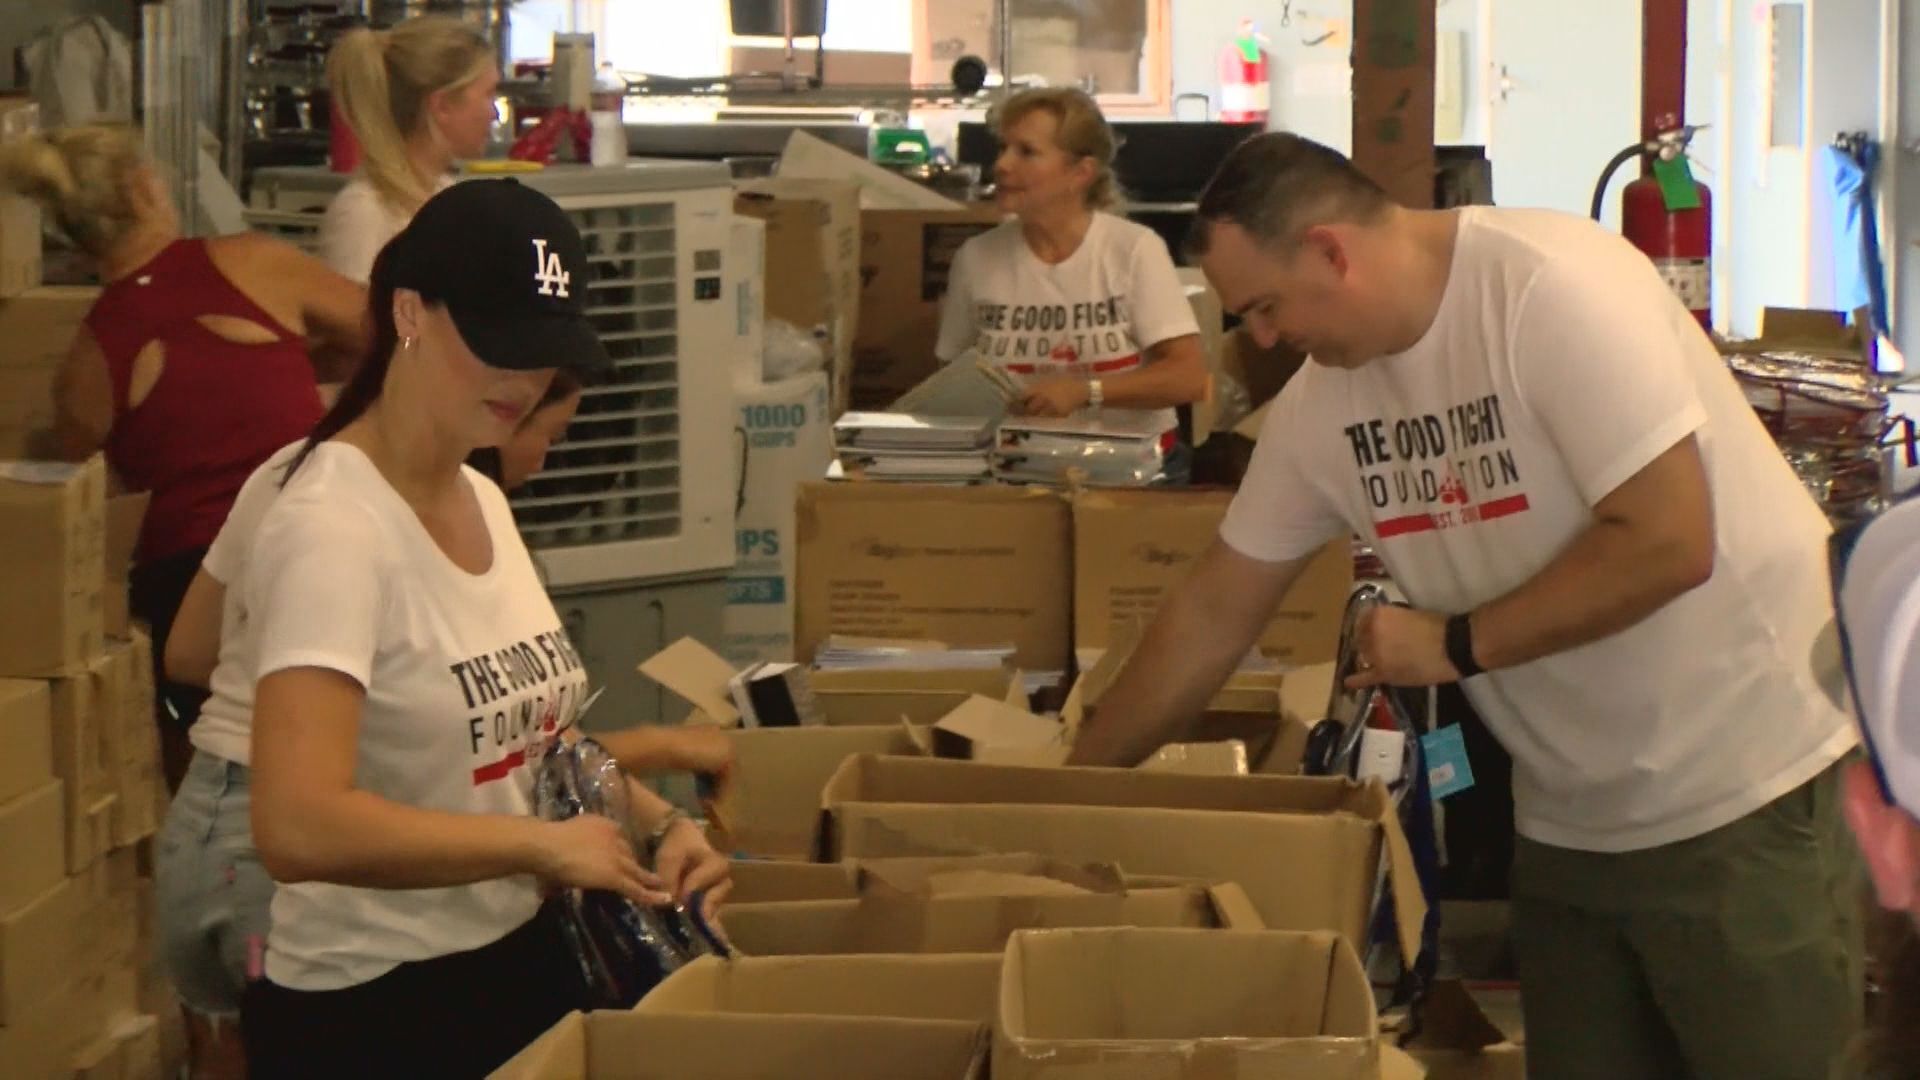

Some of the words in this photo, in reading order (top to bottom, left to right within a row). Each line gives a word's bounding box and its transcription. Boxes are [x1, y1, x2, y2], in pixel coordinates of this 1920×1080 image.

[532, 239, 570, 298] LA
[1010, 304, 1067, 332] GOOD
[740, 404, 806, 429] 1000
[1344, 419, 1392, 468] THE
[449, 653, 508, 709] THE
